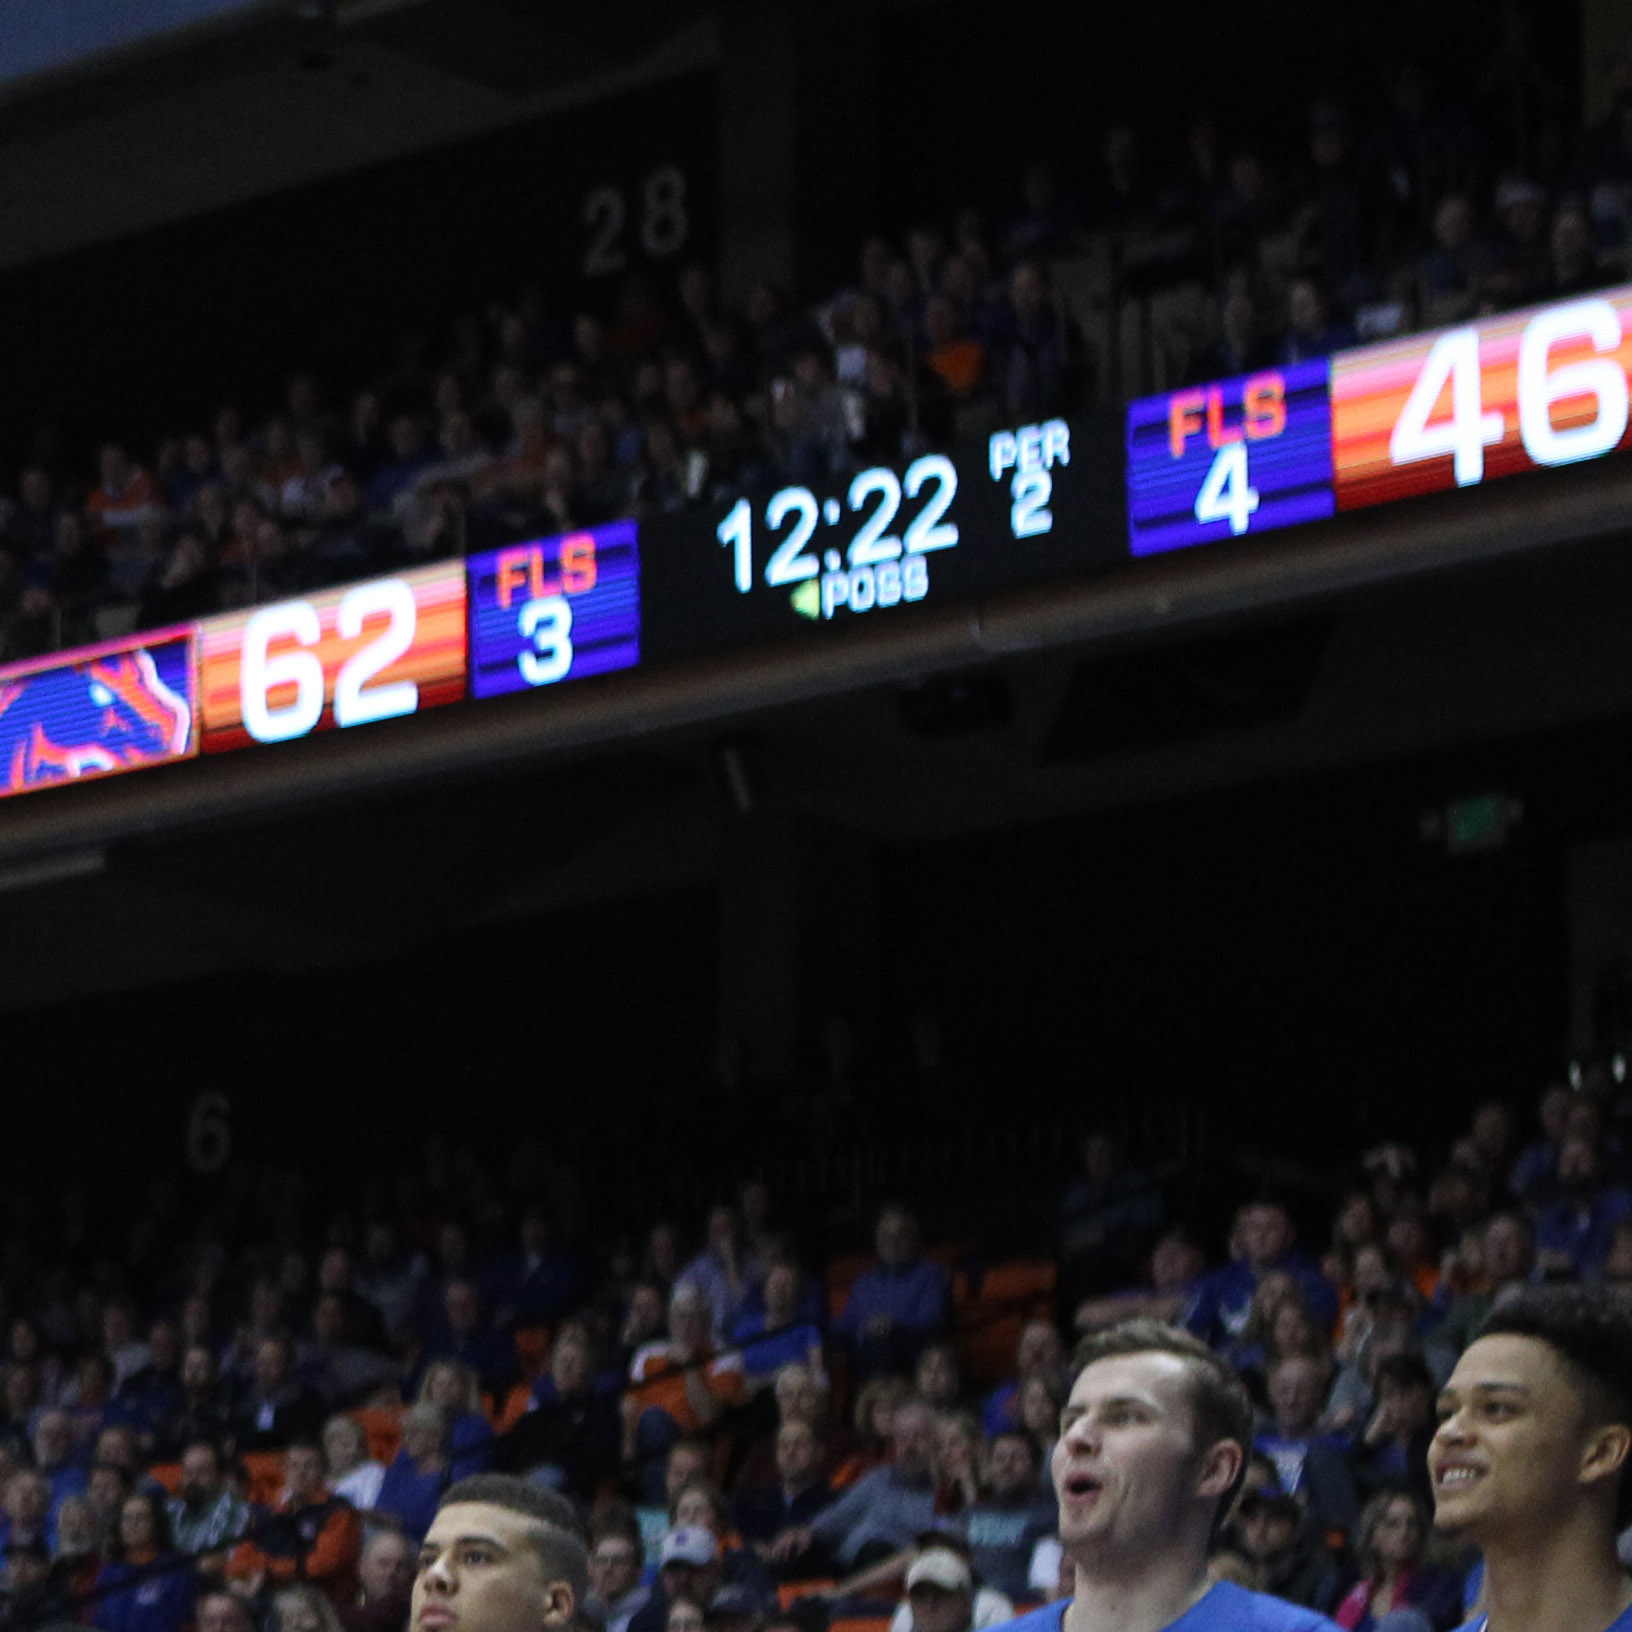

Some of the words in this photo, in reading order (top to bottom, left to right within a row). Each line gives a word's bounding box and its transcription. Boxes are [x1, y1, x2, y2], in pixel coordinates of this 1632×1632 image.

[581, 164, 689, 278] 28
[1168, 371, 1287, 460] FLS
[1390, 299, 1630, 488] 46
[989, 418, 1071, 482] PER
[1193, 440, 1260, 536] 4
[717, 454, 960, 594] 12:22
[1010, 470, 1054, 539] 2
[495, 531, 598, 610] FLS
[240, 578, 420, 745] 62
[517, 595, 575, 687] 3
[187, 1089, 233, 1174] 6
